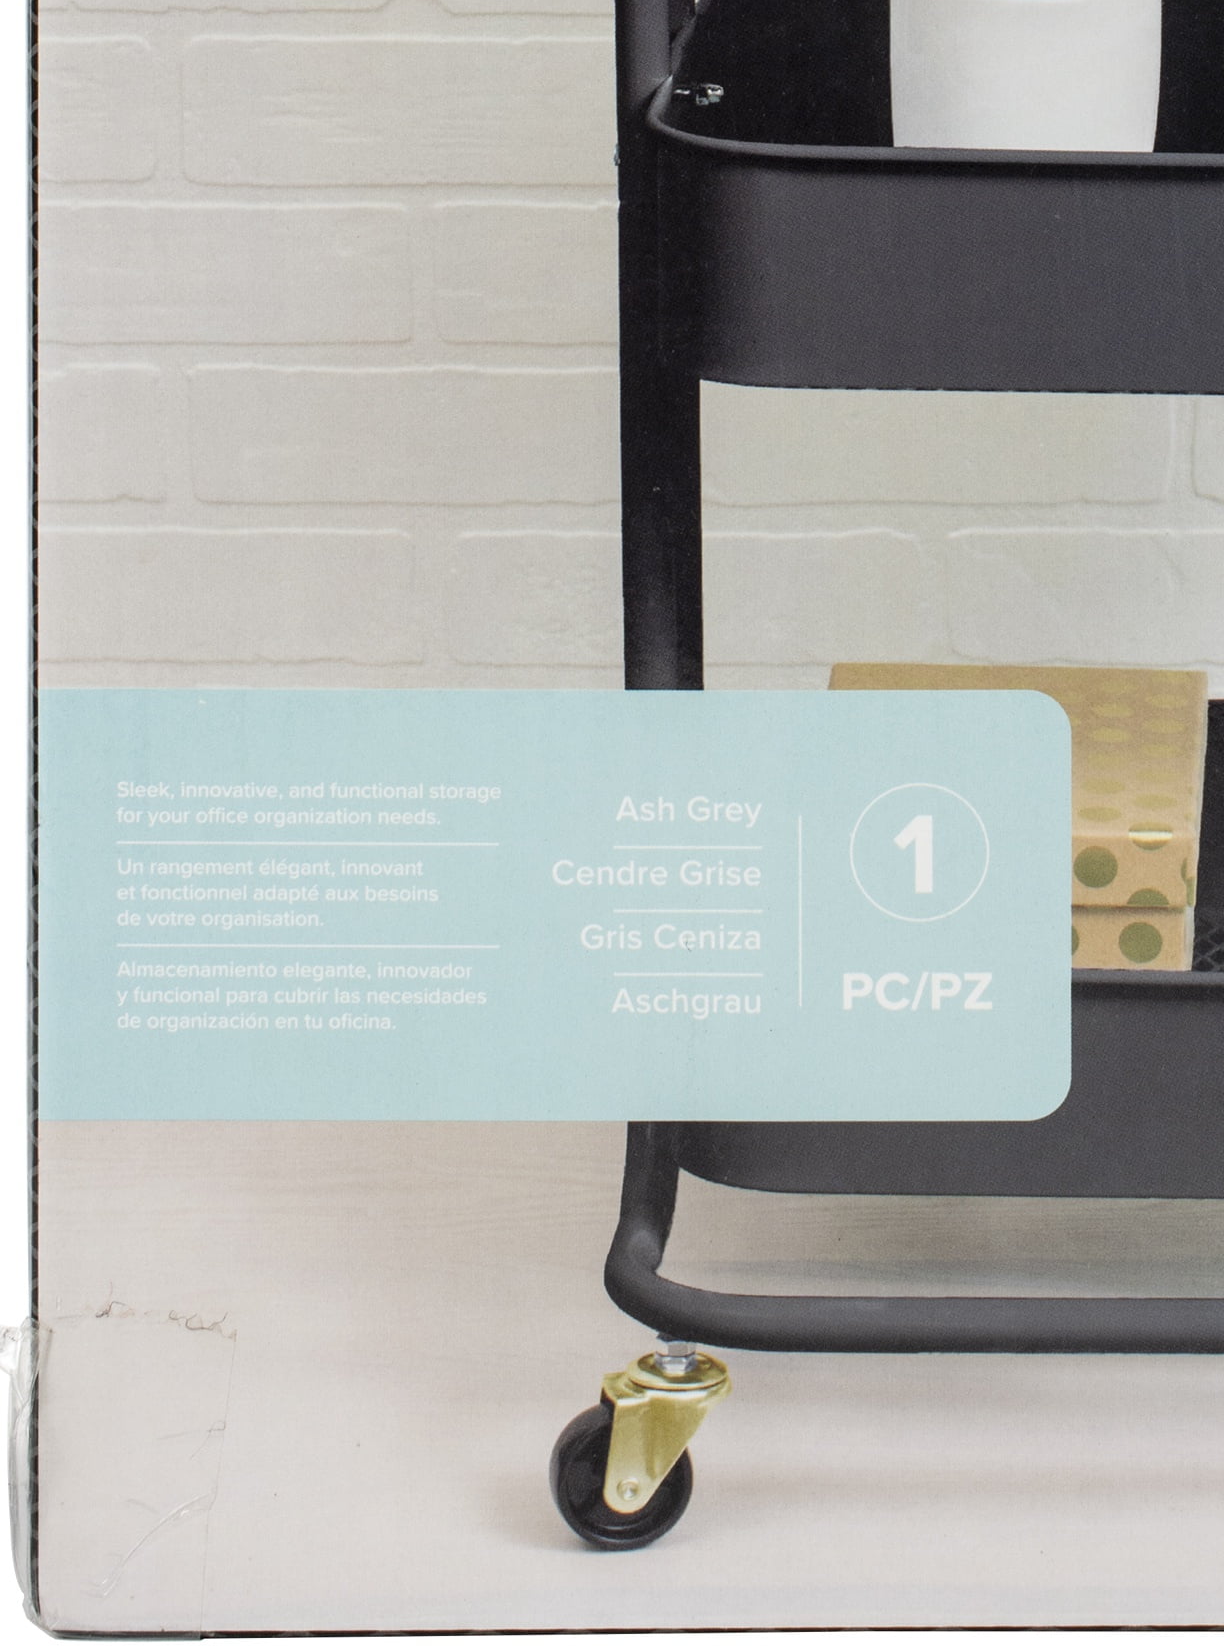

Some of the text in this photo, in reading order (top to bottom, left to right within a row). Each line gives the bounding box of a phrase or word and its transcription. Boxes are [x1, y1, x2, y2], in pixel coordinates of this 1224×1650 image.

[117, 781, 503, 804] Sleek, innovative, and functional storage
[117, 807, 442, 829] for your office organization needs.
[616, 796, 763, 829] Ash Grey
[892, 814, 935, 895] 1
[117, 859, 424, 880] Un rangement élégant, innovant
[551, 860, 763, 887] Cendre Grise
[117, 885, 440, 906] et fonctionnel adapté aux besoins
[117, 910, 325, 931] de votre organisation.
[579, 923, 762, 952] Gris Ceniza
[117, 961, 472, 983] Almacenamiento elegante, innovador
[117, 987, 488, 1009] y funcional para cubrir las necesidades
[842, 971, 994, 1012] PC/PZ
[611, 988, 763, 1021] Aschgrau
[117, 1013, 397, 1035] de organización en tu oficina.
